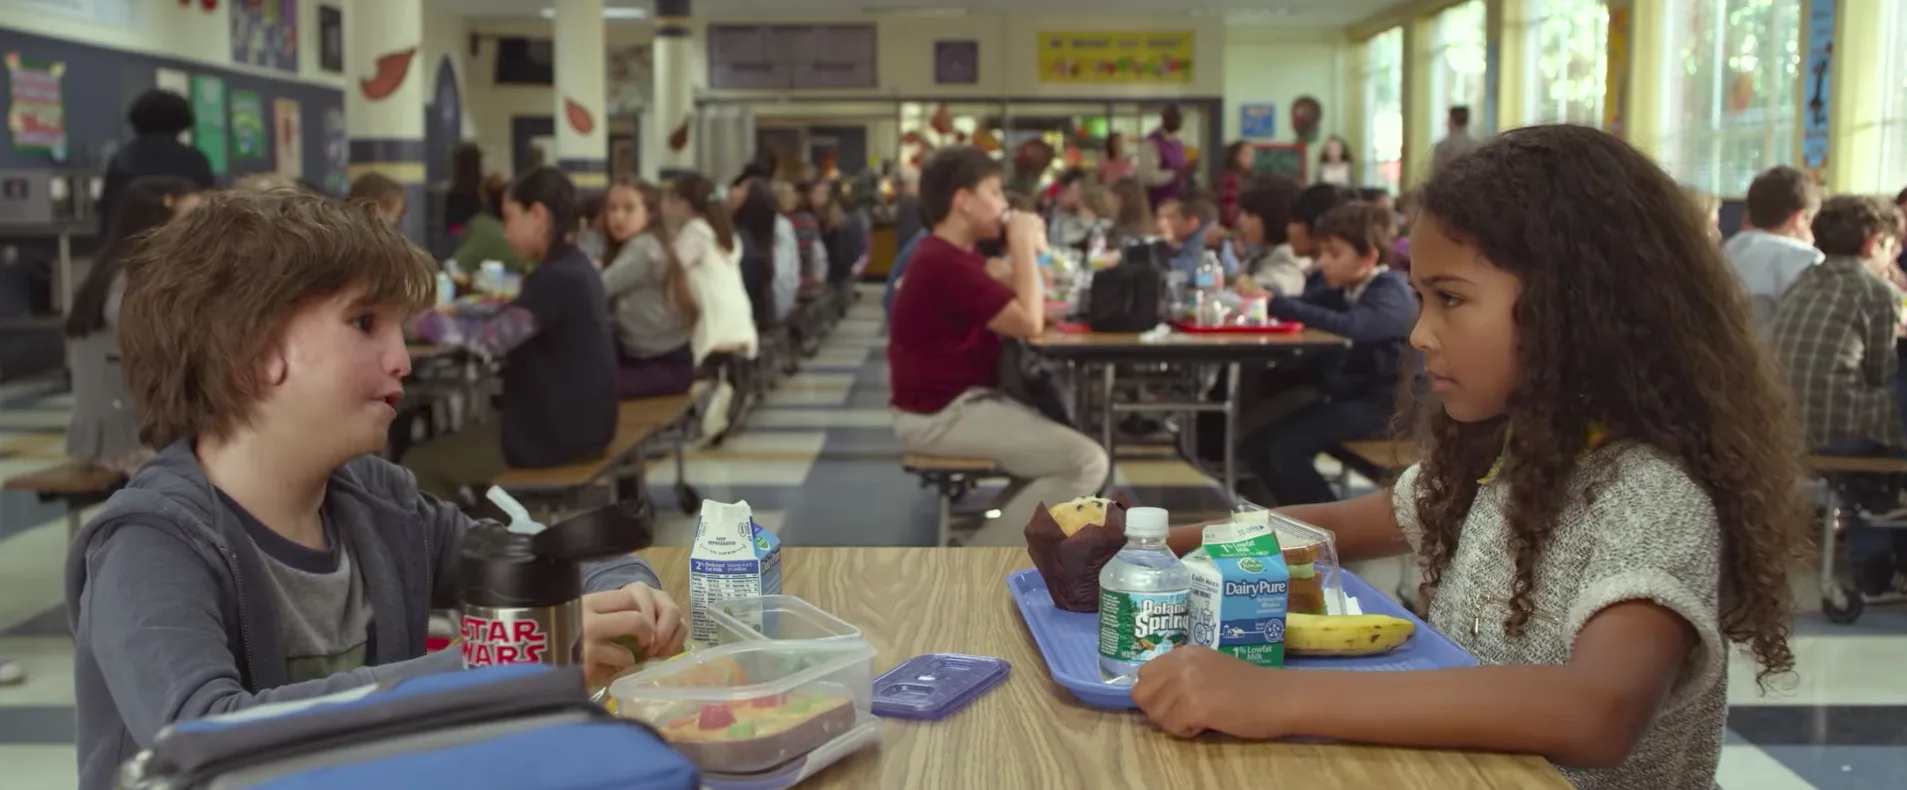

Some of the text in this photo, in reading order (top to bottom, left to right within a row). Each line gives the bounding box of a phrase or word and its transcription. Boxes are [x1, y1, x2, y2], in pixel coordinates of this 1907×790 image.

[1225, 579, 1286, 598] DairyPure
[461, 615, 546, 643] STAR
[1134, 612, 1189, 638] Spring
[1247, 645, 1272, 653] Lowfat
[1247, 653, 1263, 661] Milk
